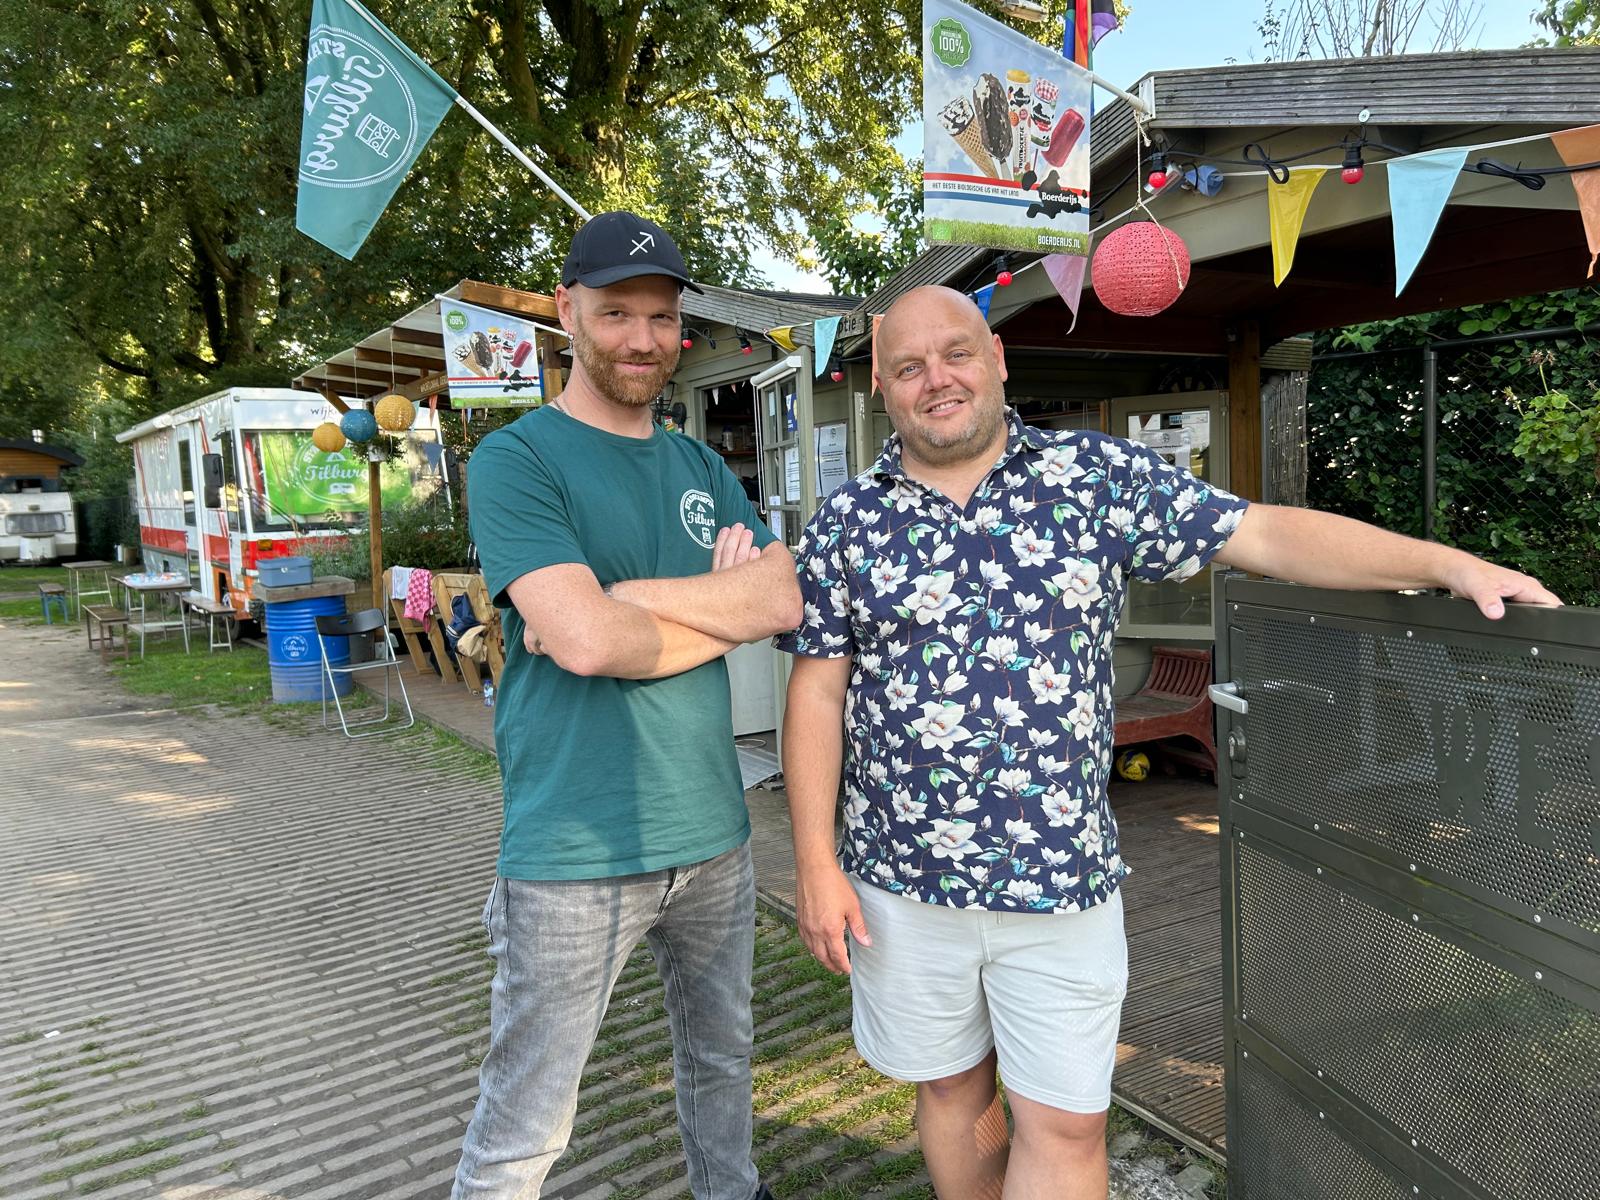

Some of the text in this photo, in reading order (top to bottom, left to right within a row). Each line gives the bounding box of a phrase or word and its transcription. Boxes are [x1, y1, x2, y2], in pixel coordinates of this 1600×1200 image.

[939, 36, 964, 54] 100%
[1041, 191, 1077, 205] Boerderijs
[1037, 234, 1081, 249] BOERDERIJS.NL
[310, 405, 337, 420] wijk
[303, 445, 320, 464] STA
[687, 512, 715, 527] Tilbur
[1430, 698, 1600, 857] WE
